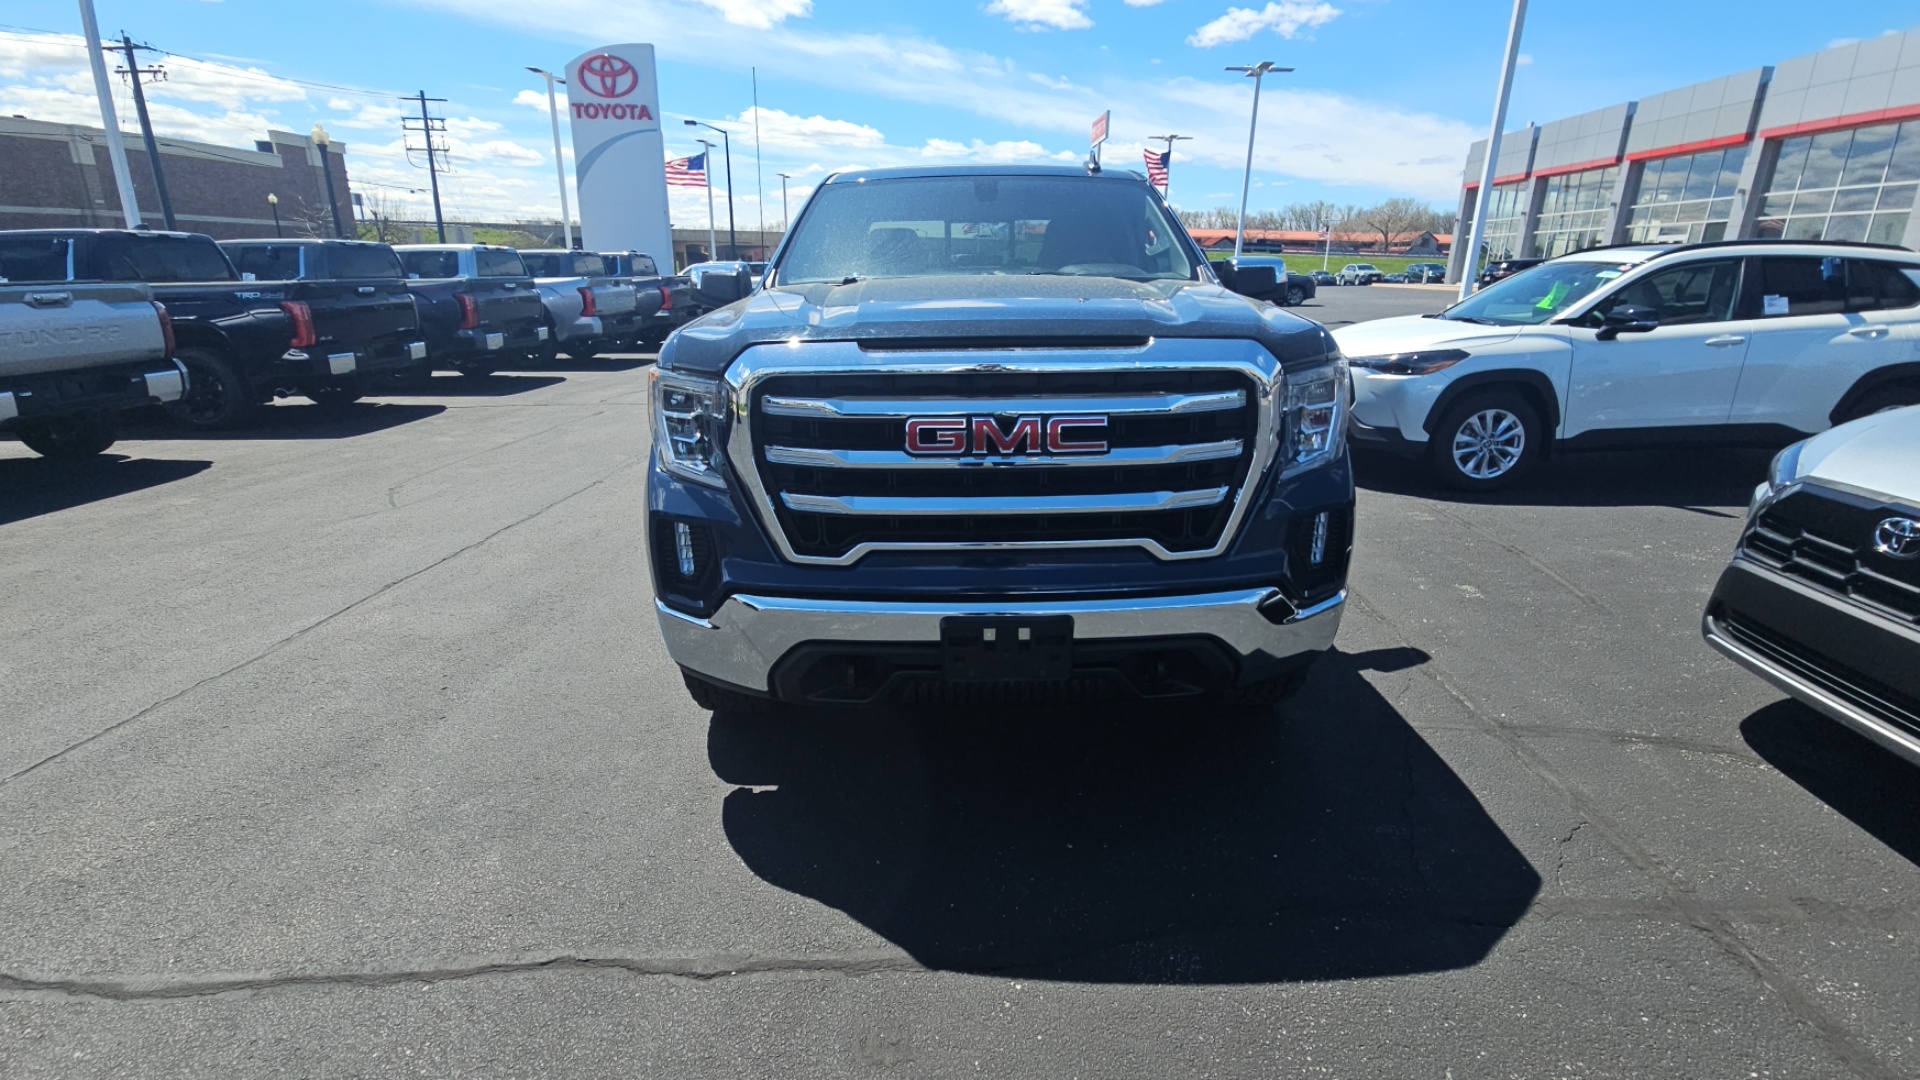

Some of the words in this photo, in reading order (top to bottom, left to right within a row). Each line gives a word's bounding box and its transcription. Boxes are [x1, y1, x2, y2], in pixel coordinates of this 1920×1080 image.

[571, 103, 653, 121] TOYOTA
[0, 325, 125, 347] TUNDRA
[905, 417, 1108, 454] GMC
